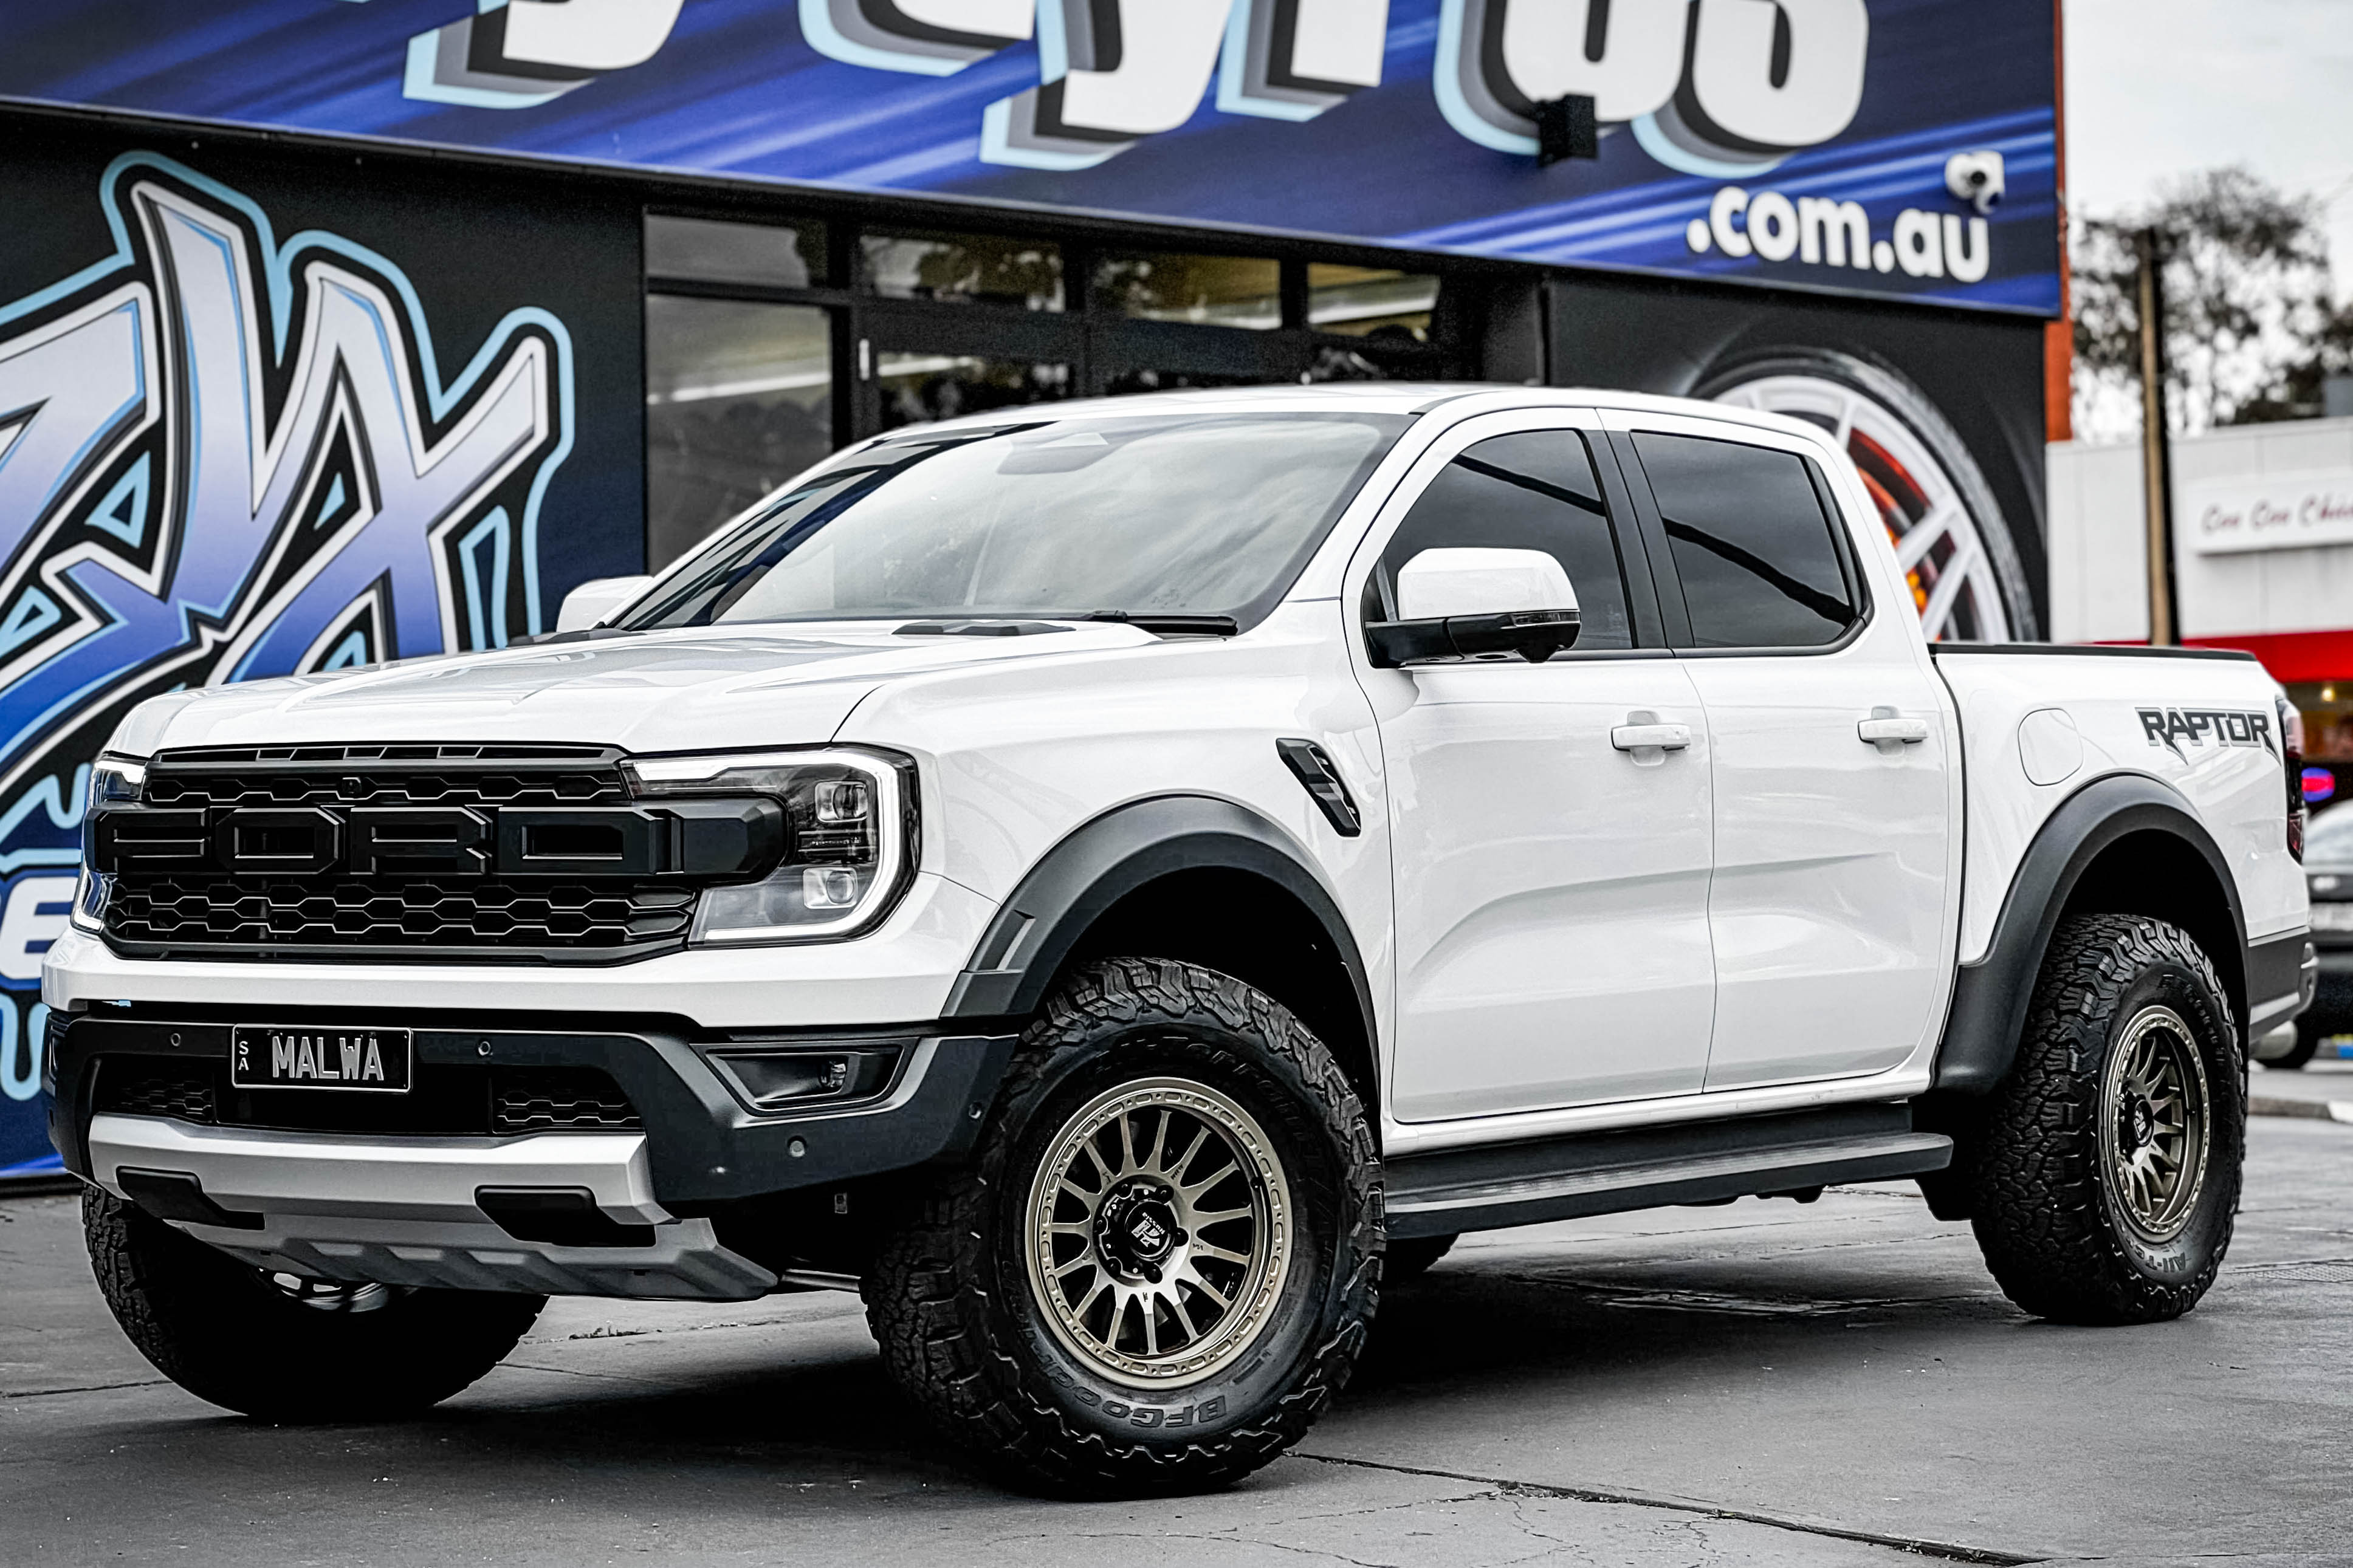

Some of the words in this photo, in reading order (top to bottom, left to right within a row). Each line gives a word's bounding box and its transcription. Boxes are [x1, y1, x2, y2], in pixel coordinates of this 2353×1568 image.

[1686, 186, 1990, 283] .com.au
[2135, 707, 2281, 766] RAPTOR
[85, 806, 659, 876] FORD
[272, 1036, 385, 1081] MALWA
[1014, 1300, 1227, 1429] BFGoodr
